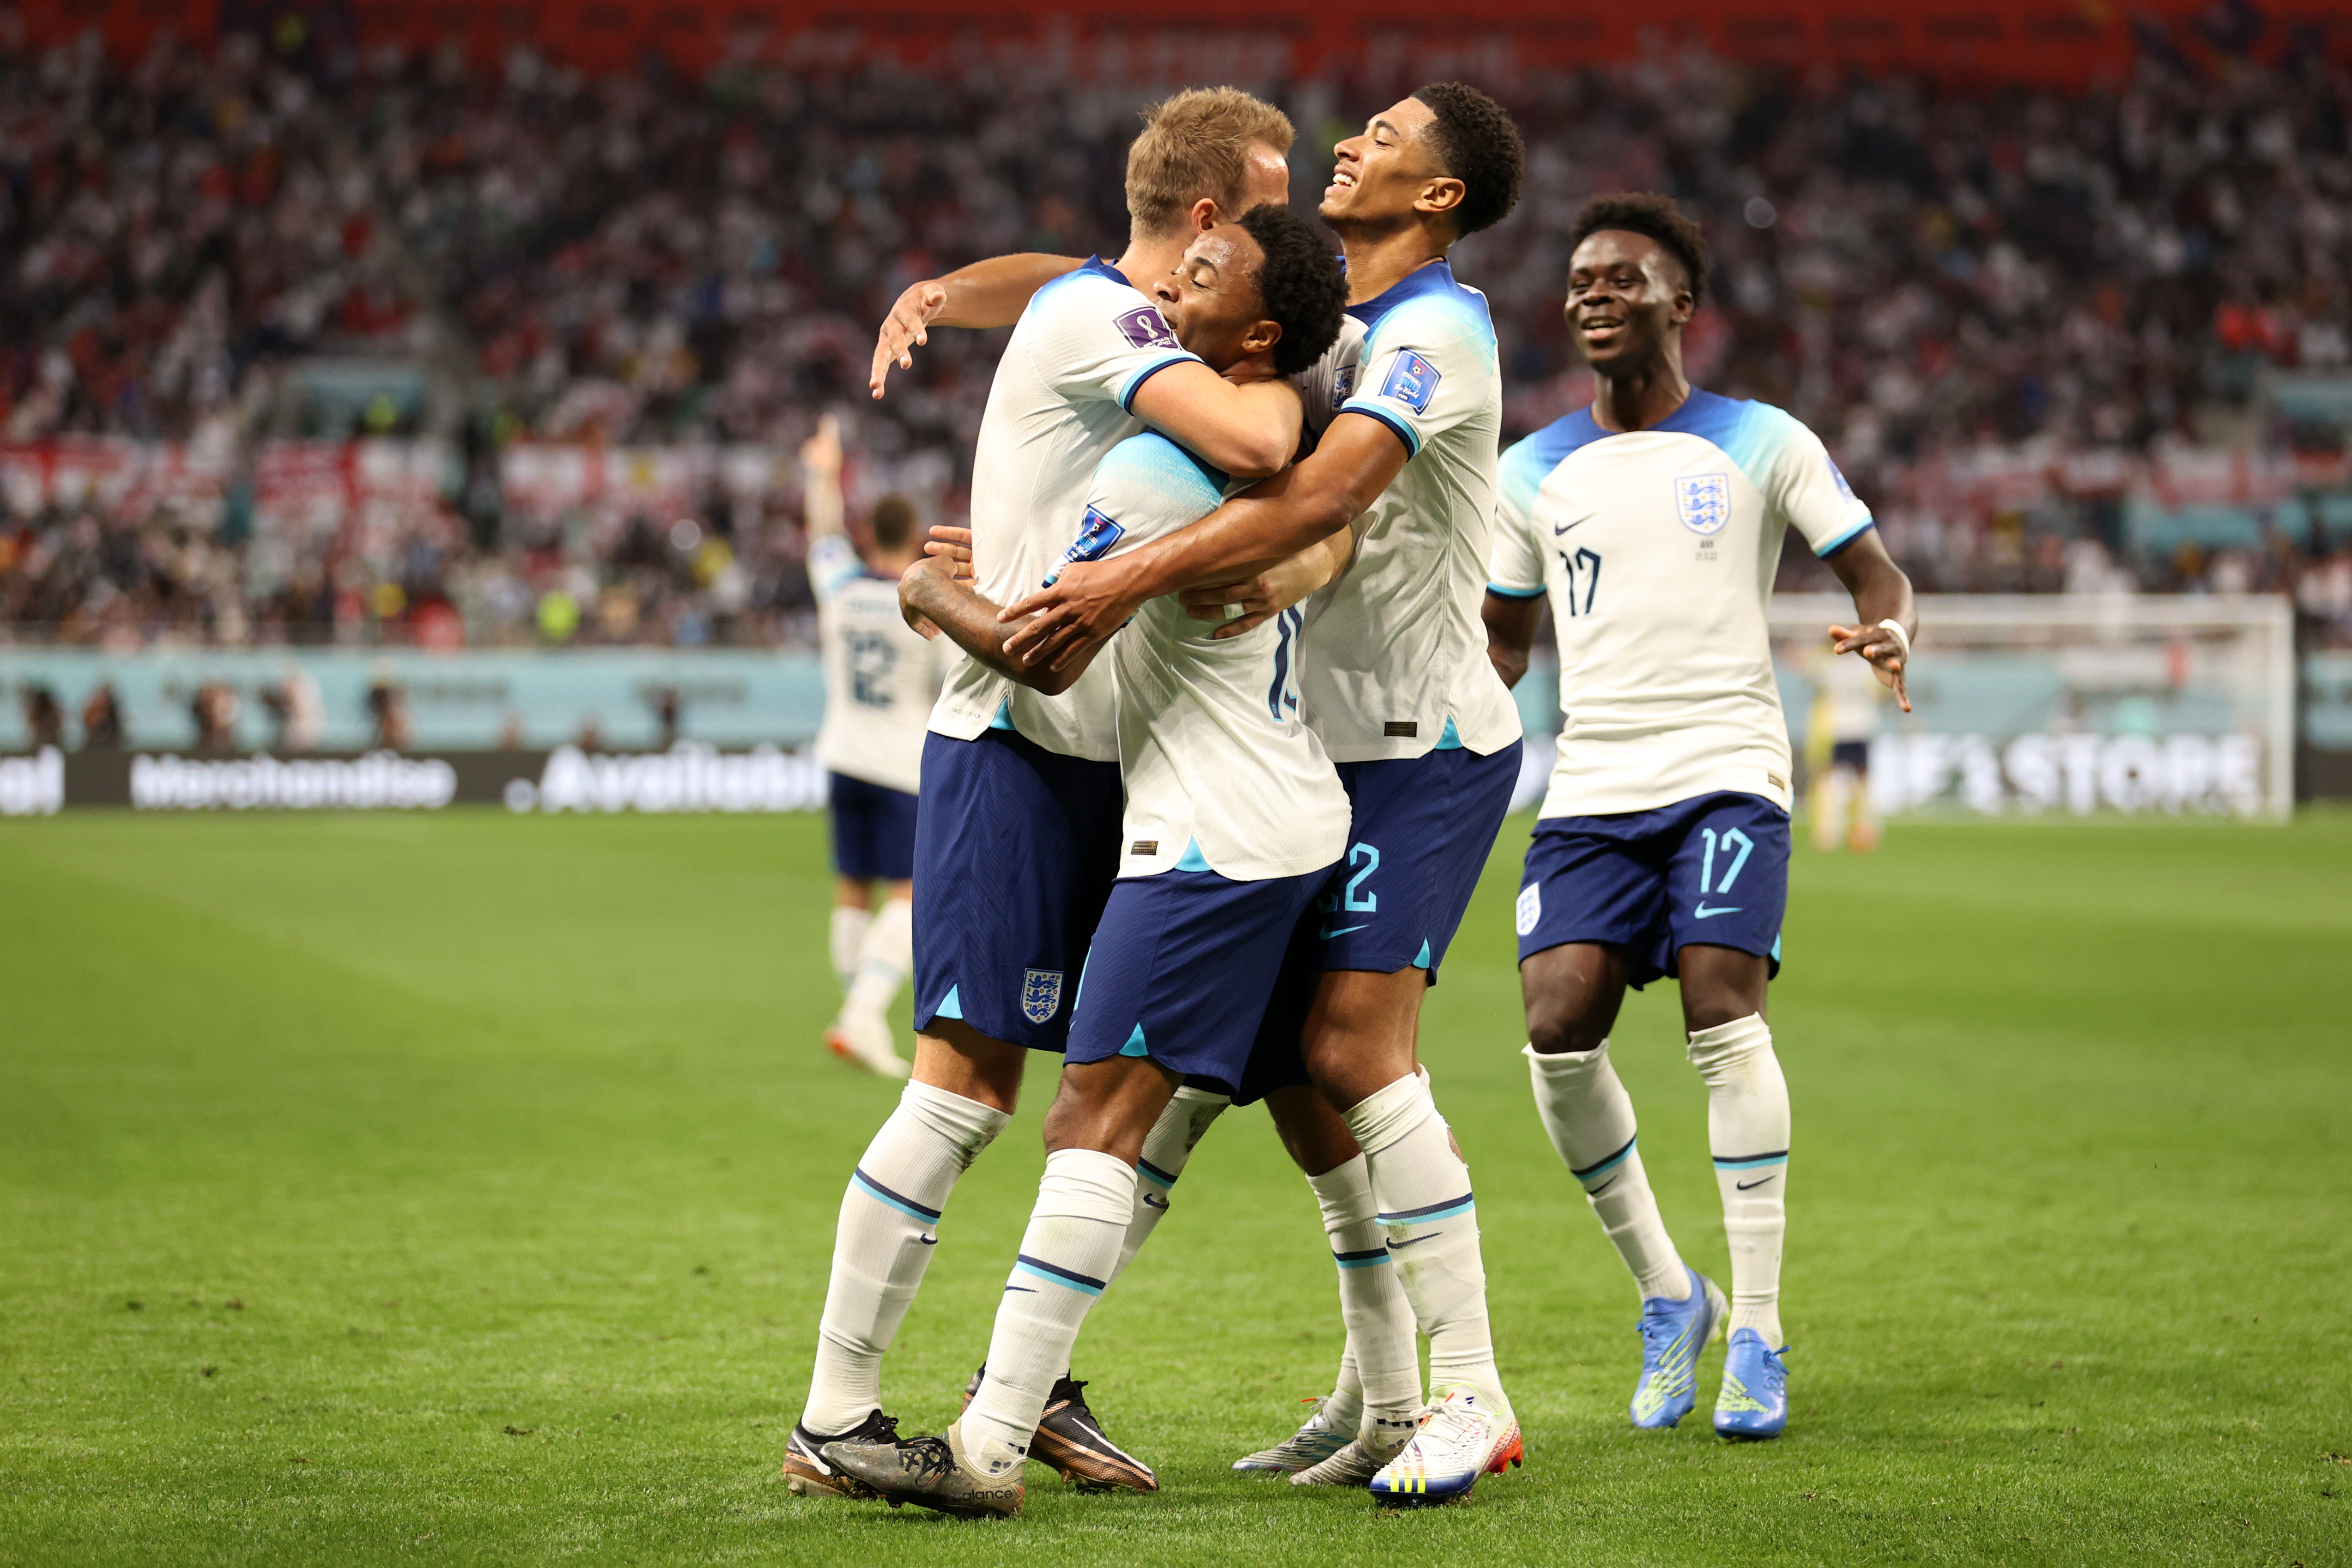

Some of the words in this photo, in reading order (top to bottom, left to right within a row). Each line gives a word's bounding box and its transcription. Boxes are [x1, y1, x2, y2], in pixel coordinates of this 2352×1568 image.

[1398, 376, 1421, 393] UNITES
[1401, 371, 1422, 387] FOOTBALL
[1402, 386, 1420, 400] World
[1558, 547, 1601, 618] 17
[130, 751, 458, 809] Merchandise
[1700, 827, 1754, 894] 17
